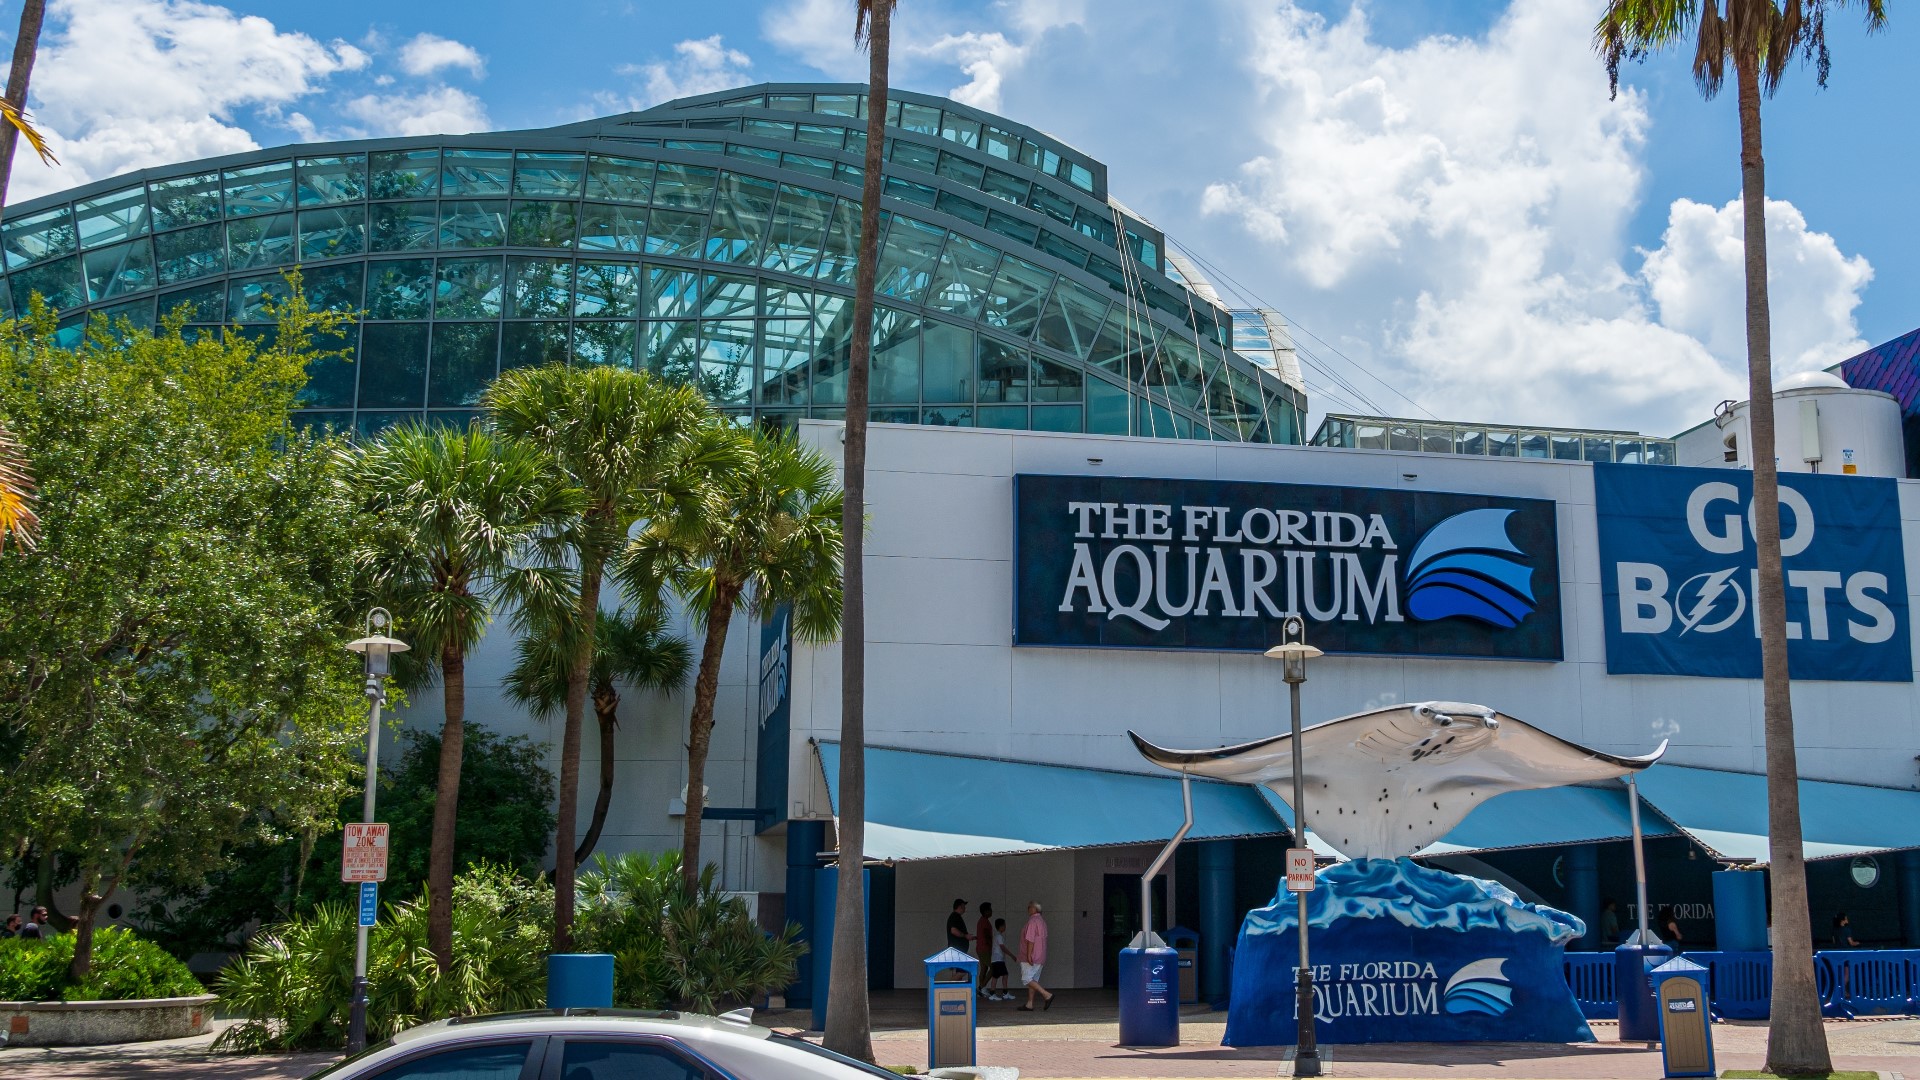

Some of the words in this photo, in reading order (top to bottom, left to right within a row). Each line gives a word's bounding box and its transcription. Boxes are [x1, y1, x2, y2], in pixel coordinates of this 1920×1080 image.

[1069, 501, 1173, 541] THE
[1181, 505, 1398, 549] FLORIDA
[1687, 481, 1815, 557] GO
[1058, 542, 1405, 632] AQUARIUM
[347, 825, 363, 837] TOW
[366, 825, 387, 837] AWAY
[356, 836, 377, 847] ZONE
[1294, 858, 1307, 867] NO
[1288, 873, 1313, 882] PARKING
[1627, 903, 1654, 920] TE
[1658, 903, 1715, 920] ORIDA
[1291, 964, 1332, 983] THE
[1340, 961, 1439, 981] FLORIDA
